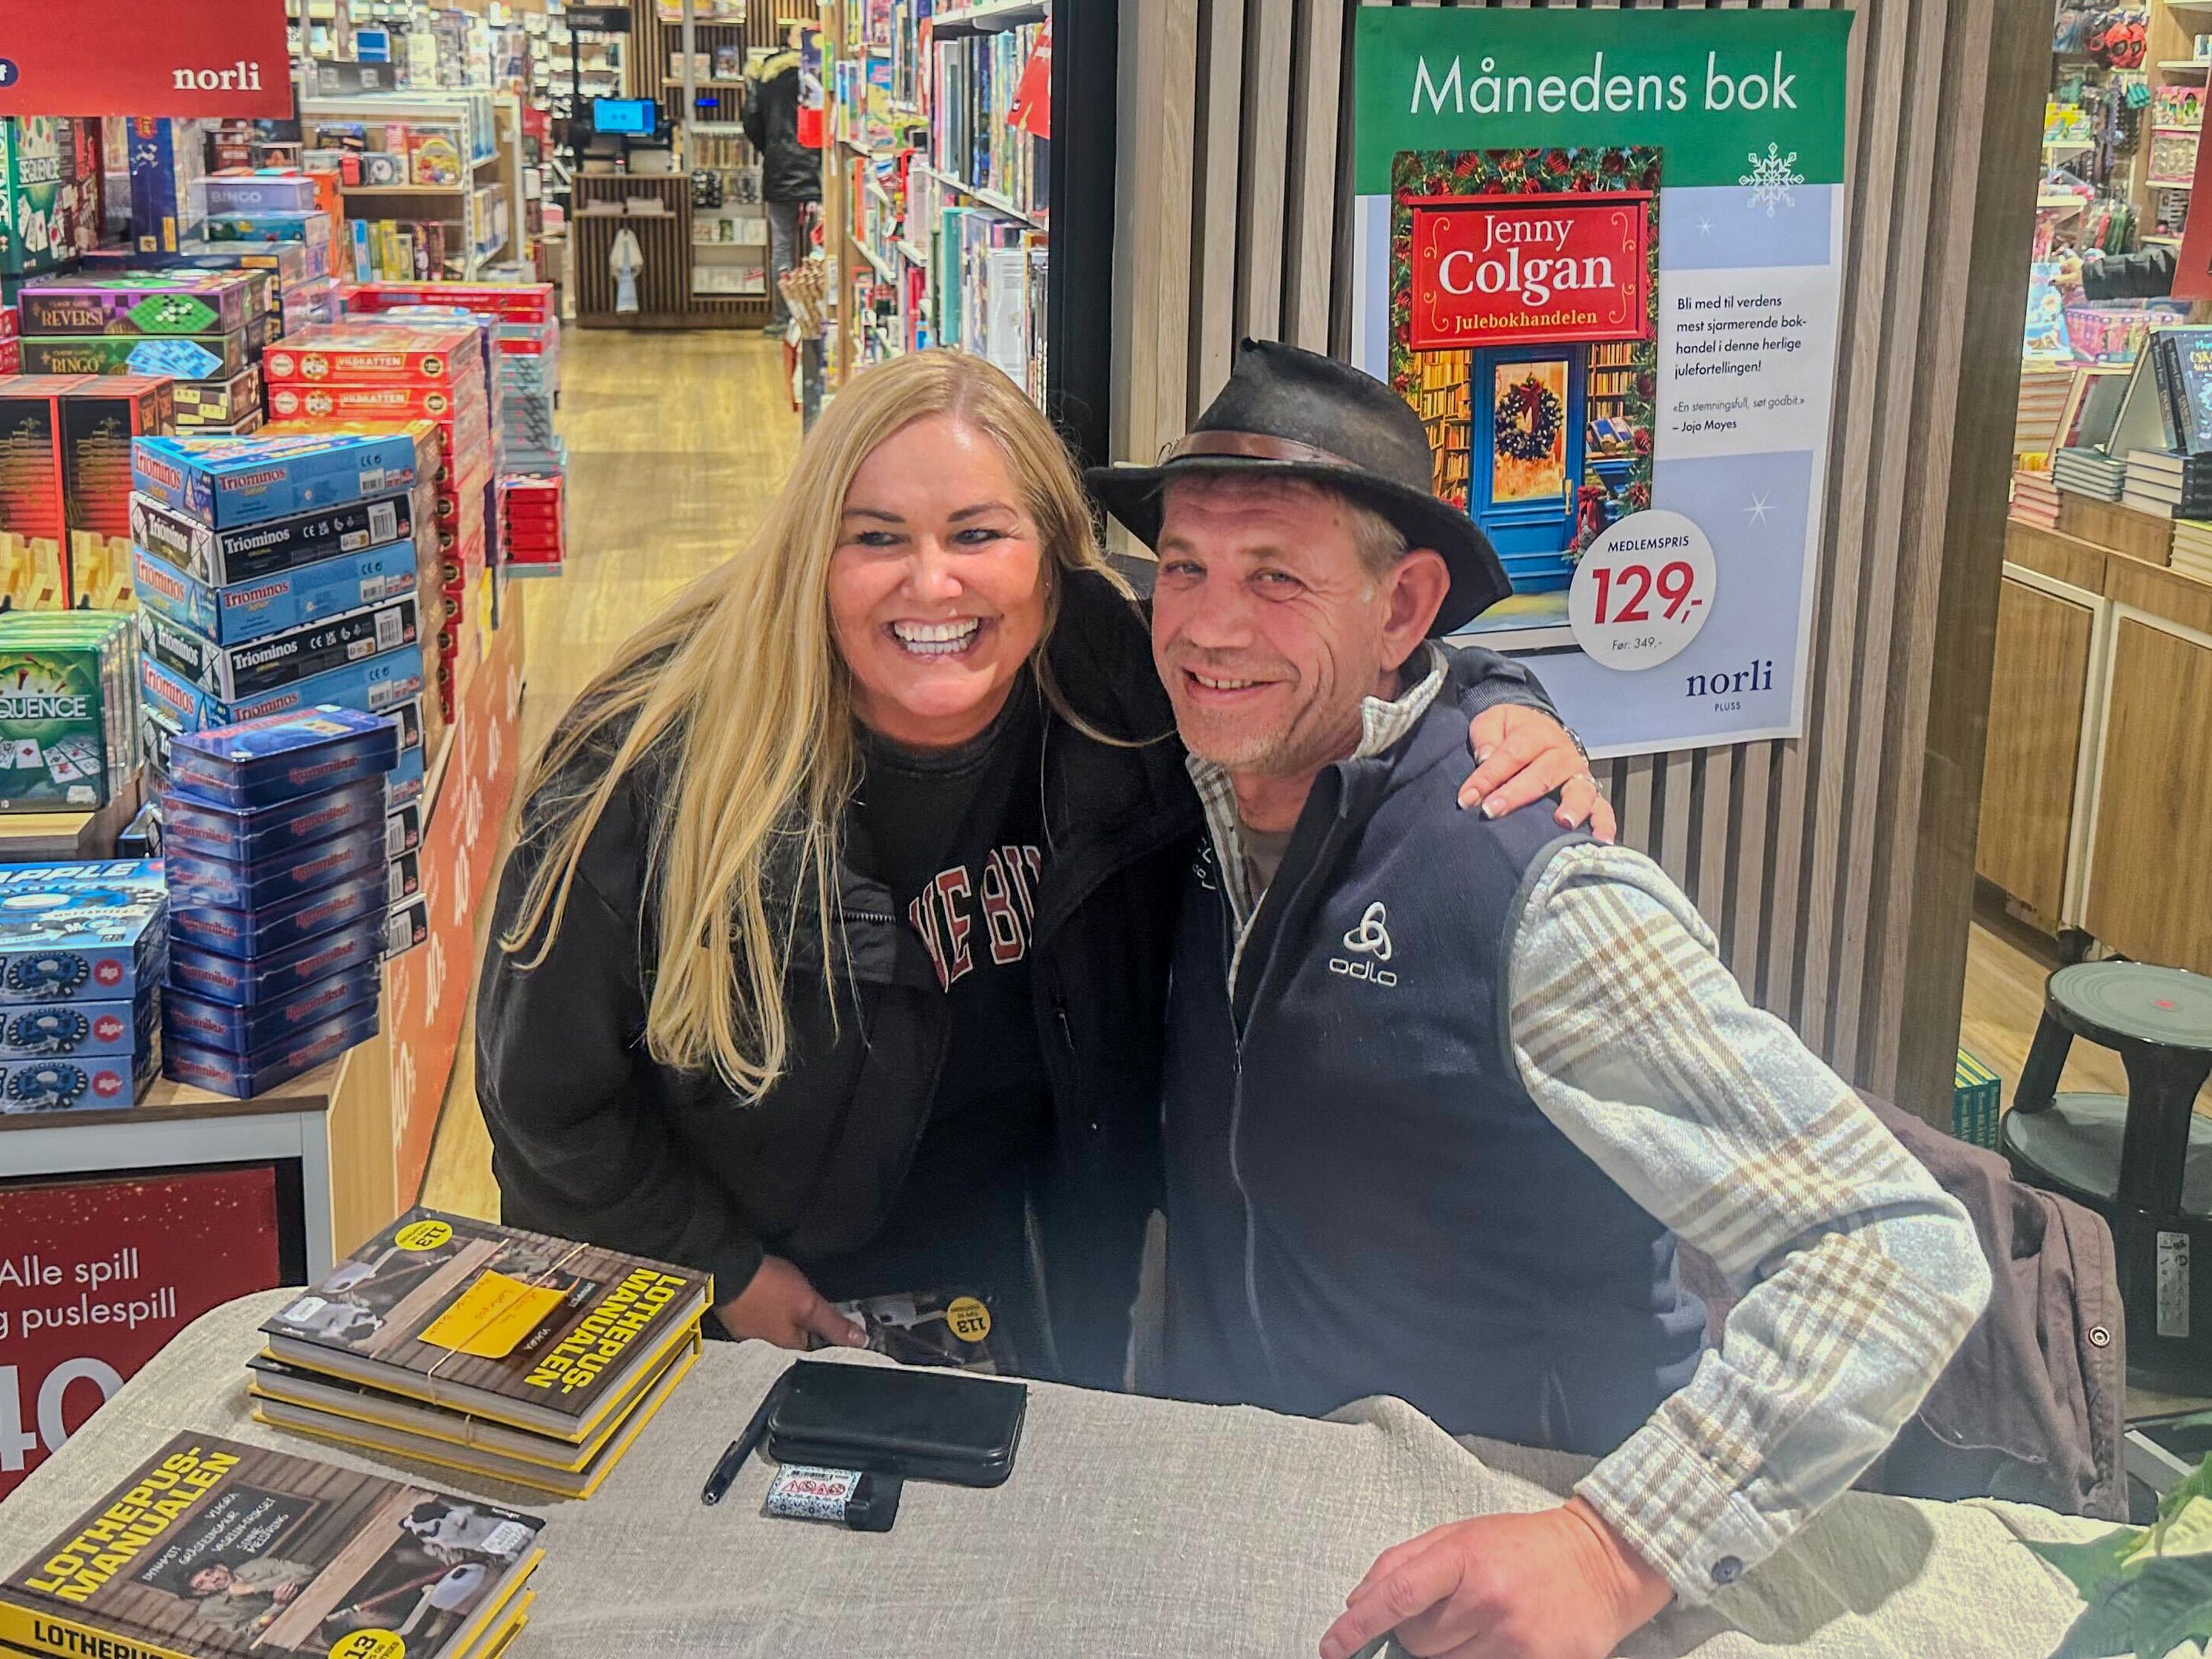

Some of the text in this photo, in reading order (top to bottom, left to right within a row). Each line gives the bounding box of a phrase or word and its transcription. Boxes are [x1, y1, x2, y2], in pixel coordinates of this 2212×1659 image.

[173, 62, 262, 92] norli
[1410, 51, 1797, 115] Månedens bok
[1482, 216, 1574, 251] Jenny
[1438, 249, 1615, 307] Colgan
[1678, 294, 1782, 310] Bli med til verdens
[42, 311, 104, 326] REVERSI
[1455, 311, 1598, 333] Julebokhandelen
[1676, 314, 1807, 334] mest sjarmerende bok-
[1676, 337, 1802, 354] handel i denne herlige
[52, 356, 99, 374] BINGO
[1675, 360, 1762, 380] julefortellingen!
[1673, 401, 1689, 413] «En
[1692, 396, 1750, 414] stemningsfull,
[1753, 398, 1766, 408] søt
[1681, 421, 1702, 434] Jojo
[1703, 420, 1737, 433] Moyes
[135, 445, 181, 490] Triominos
[219, 468, 286, 491] Triominos
[225, 529, 291, 554] Triominos
[1608, 536, 1689, 553] MEDLEMSPRIS
[135, 553, 185, 603] Triominos
[1592, 561, 1703, 625] 129,-
[224, 582, 290, 608] Triominos
[233, 640, 298, 670] Triominos
[1634, 636, 1662, 650] 349,-
[143, 660, 194, 715] Triominos
[1686, 659, 1773, 697] norli
[234, 693, 298, 722] Triominos
[1714, 700, 1741, 712] PLUSS
[1330, 957, 1398, 987] odlo
[0, 1247, 140, 1291] Alle spill
[22, 1286, 176, 1338] puslespill
[523, 1268, 661, 1389] MANUALEN
[561, 1274, 687, 1394] LOTHEPUS-
[25, 1446, 201, 1592] LOTHEPUS-
[55, 1452, 241, 1603] MANUALEN
